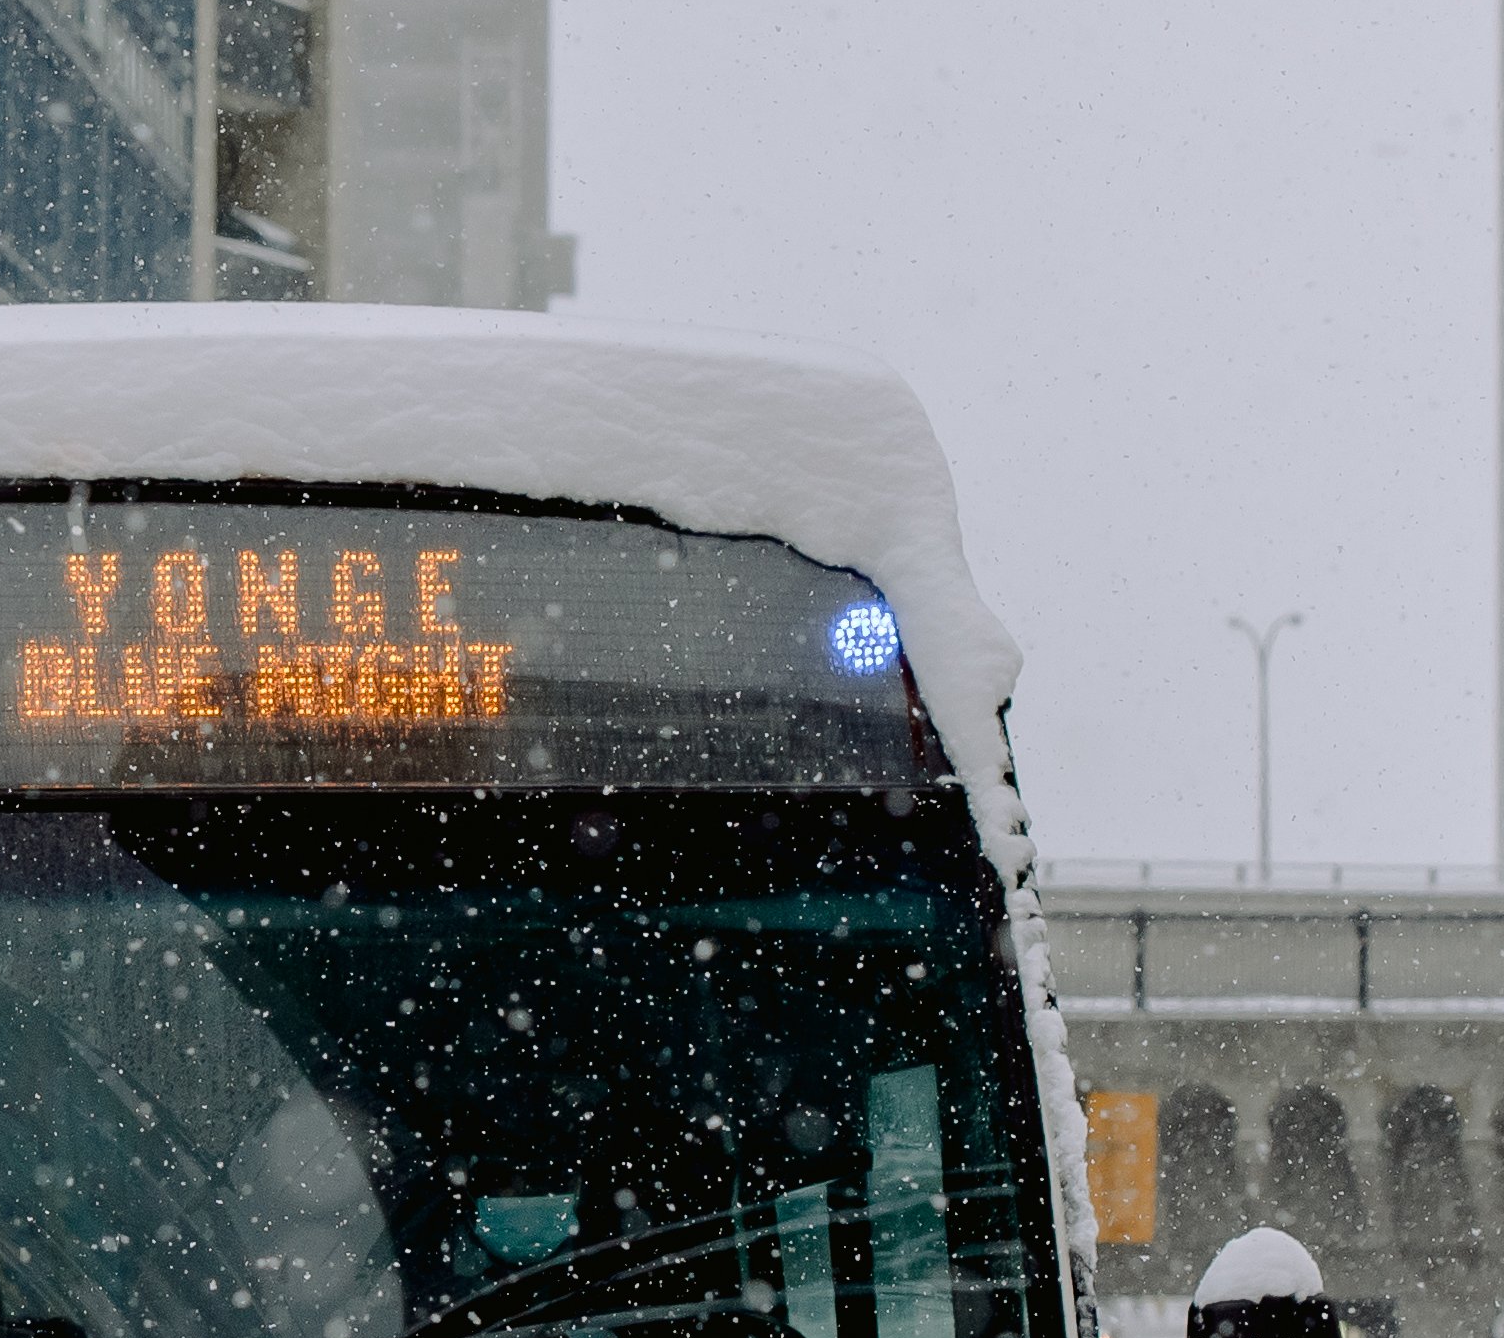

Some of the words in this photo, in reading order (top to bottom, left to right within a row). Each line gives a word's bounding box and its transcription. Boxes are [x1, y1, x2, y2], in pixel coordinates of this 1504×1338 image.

[64, 550, 462, 635] YONGE
[19, 640, 225, 717] BLUE
[254, 641, 513, 717] NIGHT
